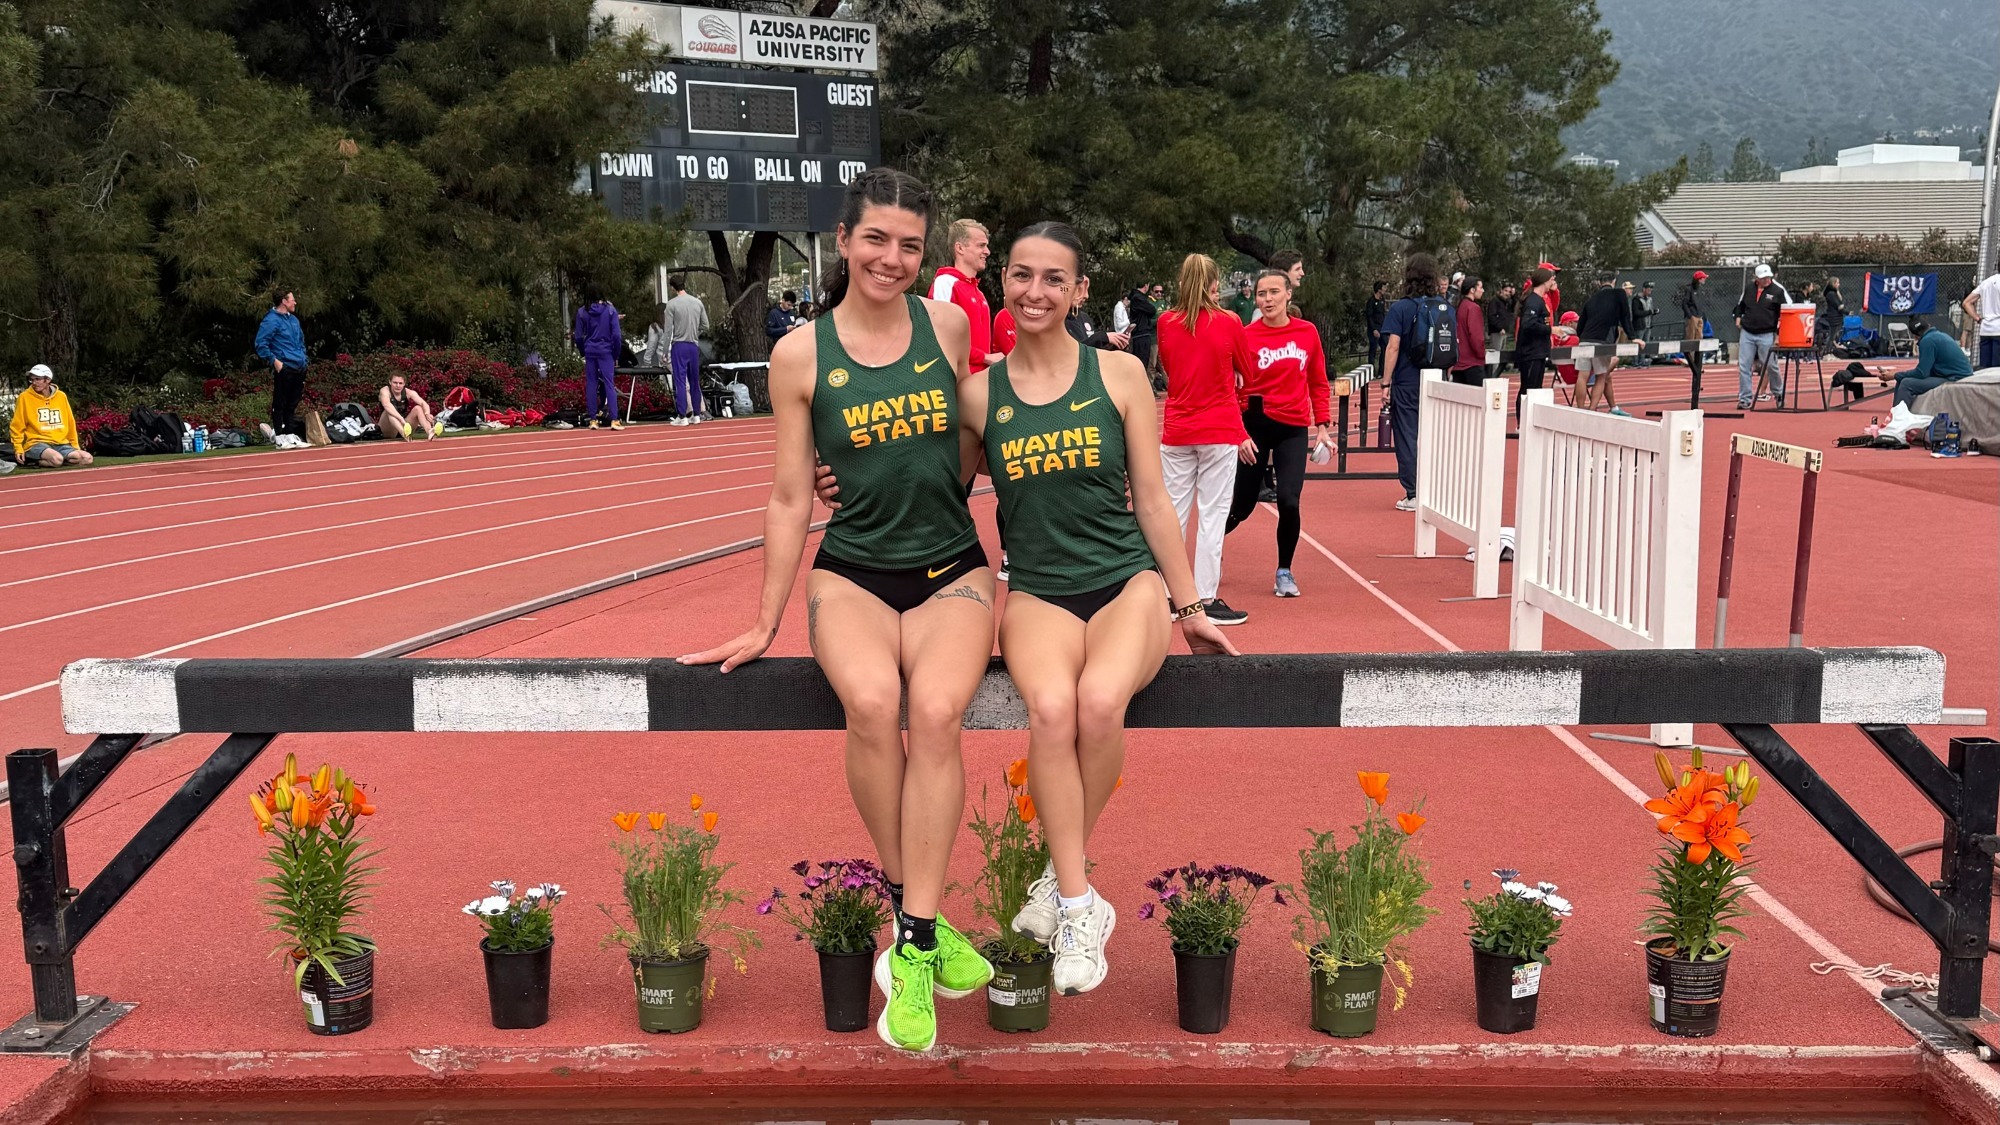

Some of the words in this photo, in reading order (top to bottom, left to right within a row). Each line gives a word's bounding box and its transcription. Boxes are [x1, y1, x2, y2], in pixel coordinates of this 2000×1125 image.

[749, 20, 806, 40] AZUSA
[809, 24, 871, 44] PACIFIC
[688, 41, 737, 55] COUGARS
[757, 40, 864, 63] UNIVERSITY
[827, 82, 874, 107] GUEST
[600, 152, 653, 177] DOWN
[676, 155, 699, 179] TO
[706, 156, 729, 180] GO
[754, 157, 795, 182] BALL
[800, 160, 822, 182] ON
[1883, 276, 1925, 293] HCU
[1257, 340, 1308, 372] Bradley
[38, 408, 61, 424] BH
[842, 389, 948, 428] WAYNE
[850, 412, 948, 449] STATE
[1001, 426, 1102, 461] WAYNE
[1751, 440, 1768, 458] AZUSA
[1768, 443, 1790, 464] PACIFIC
[1006, 448, 1101, 481] STATE
[641, 987, 674, 998] SMART
[1016, 985, 1047, 998] SMART
[1344, 990, 1376, 1001] SMART
